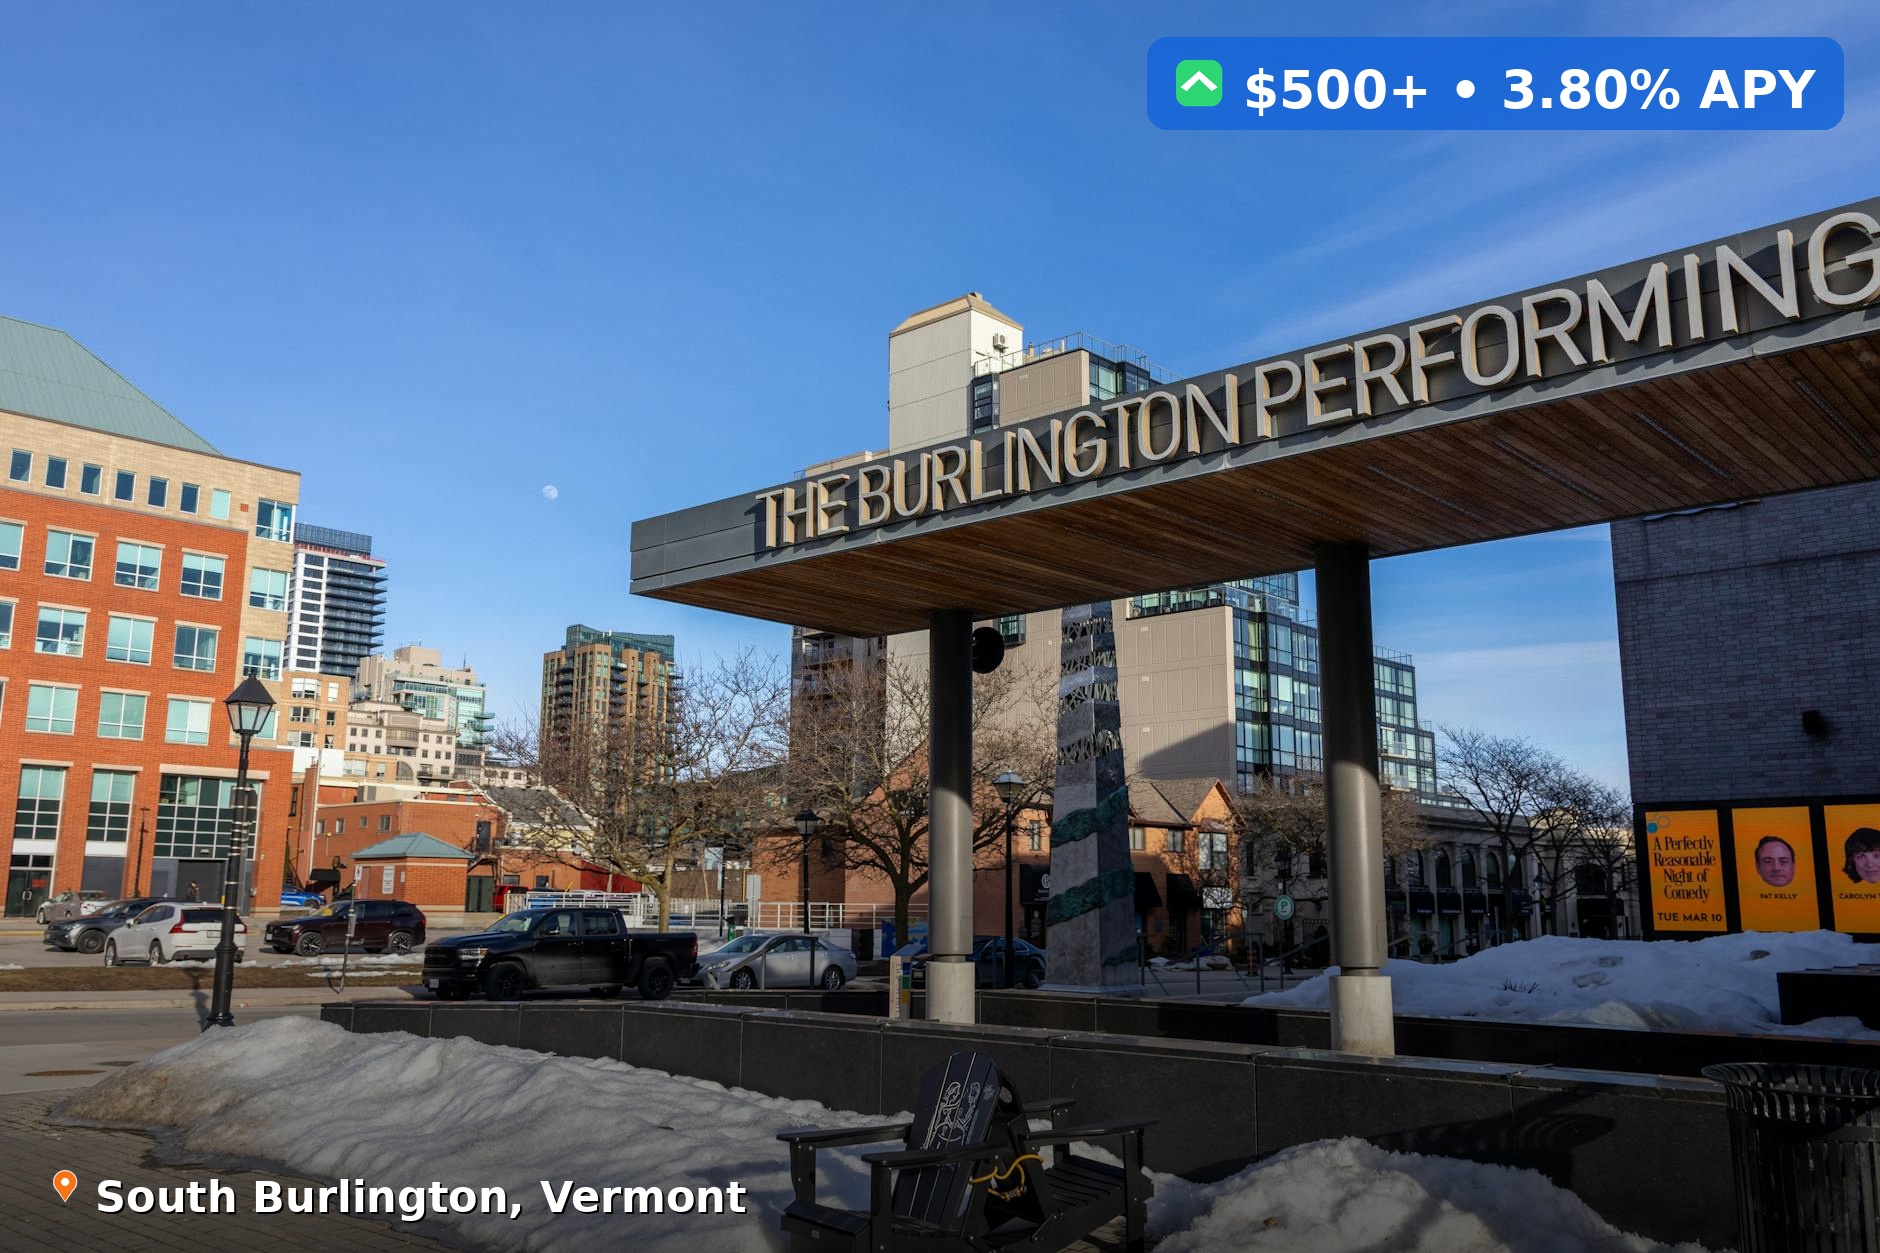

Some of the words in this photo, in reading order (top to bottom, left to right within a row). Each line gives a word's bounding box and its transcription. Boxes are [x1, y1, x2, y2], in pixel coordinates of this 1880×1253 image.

[755, 473, 850, 548] THE
[858, 373, 1239, 527] BURLINGTON
[1255, 211, 1880, 438] PERFORMING
[1654, 836, 1661, 851] A
[1665, 835, 1714, 852] Perfectly
[1654, 851, 1716, 867] Reasonable
[1664, 868, 1692, 886] Night
[1696, 868, 1709, 883] of
[1664, 885, 1709, 903] Comedy
[1281, 901, 1288, 909] P
[1658, 912, 1679, 921] TUE
[1683, 913, 1707, 922] MAR
[1712, 914, 1722, 922] 10
